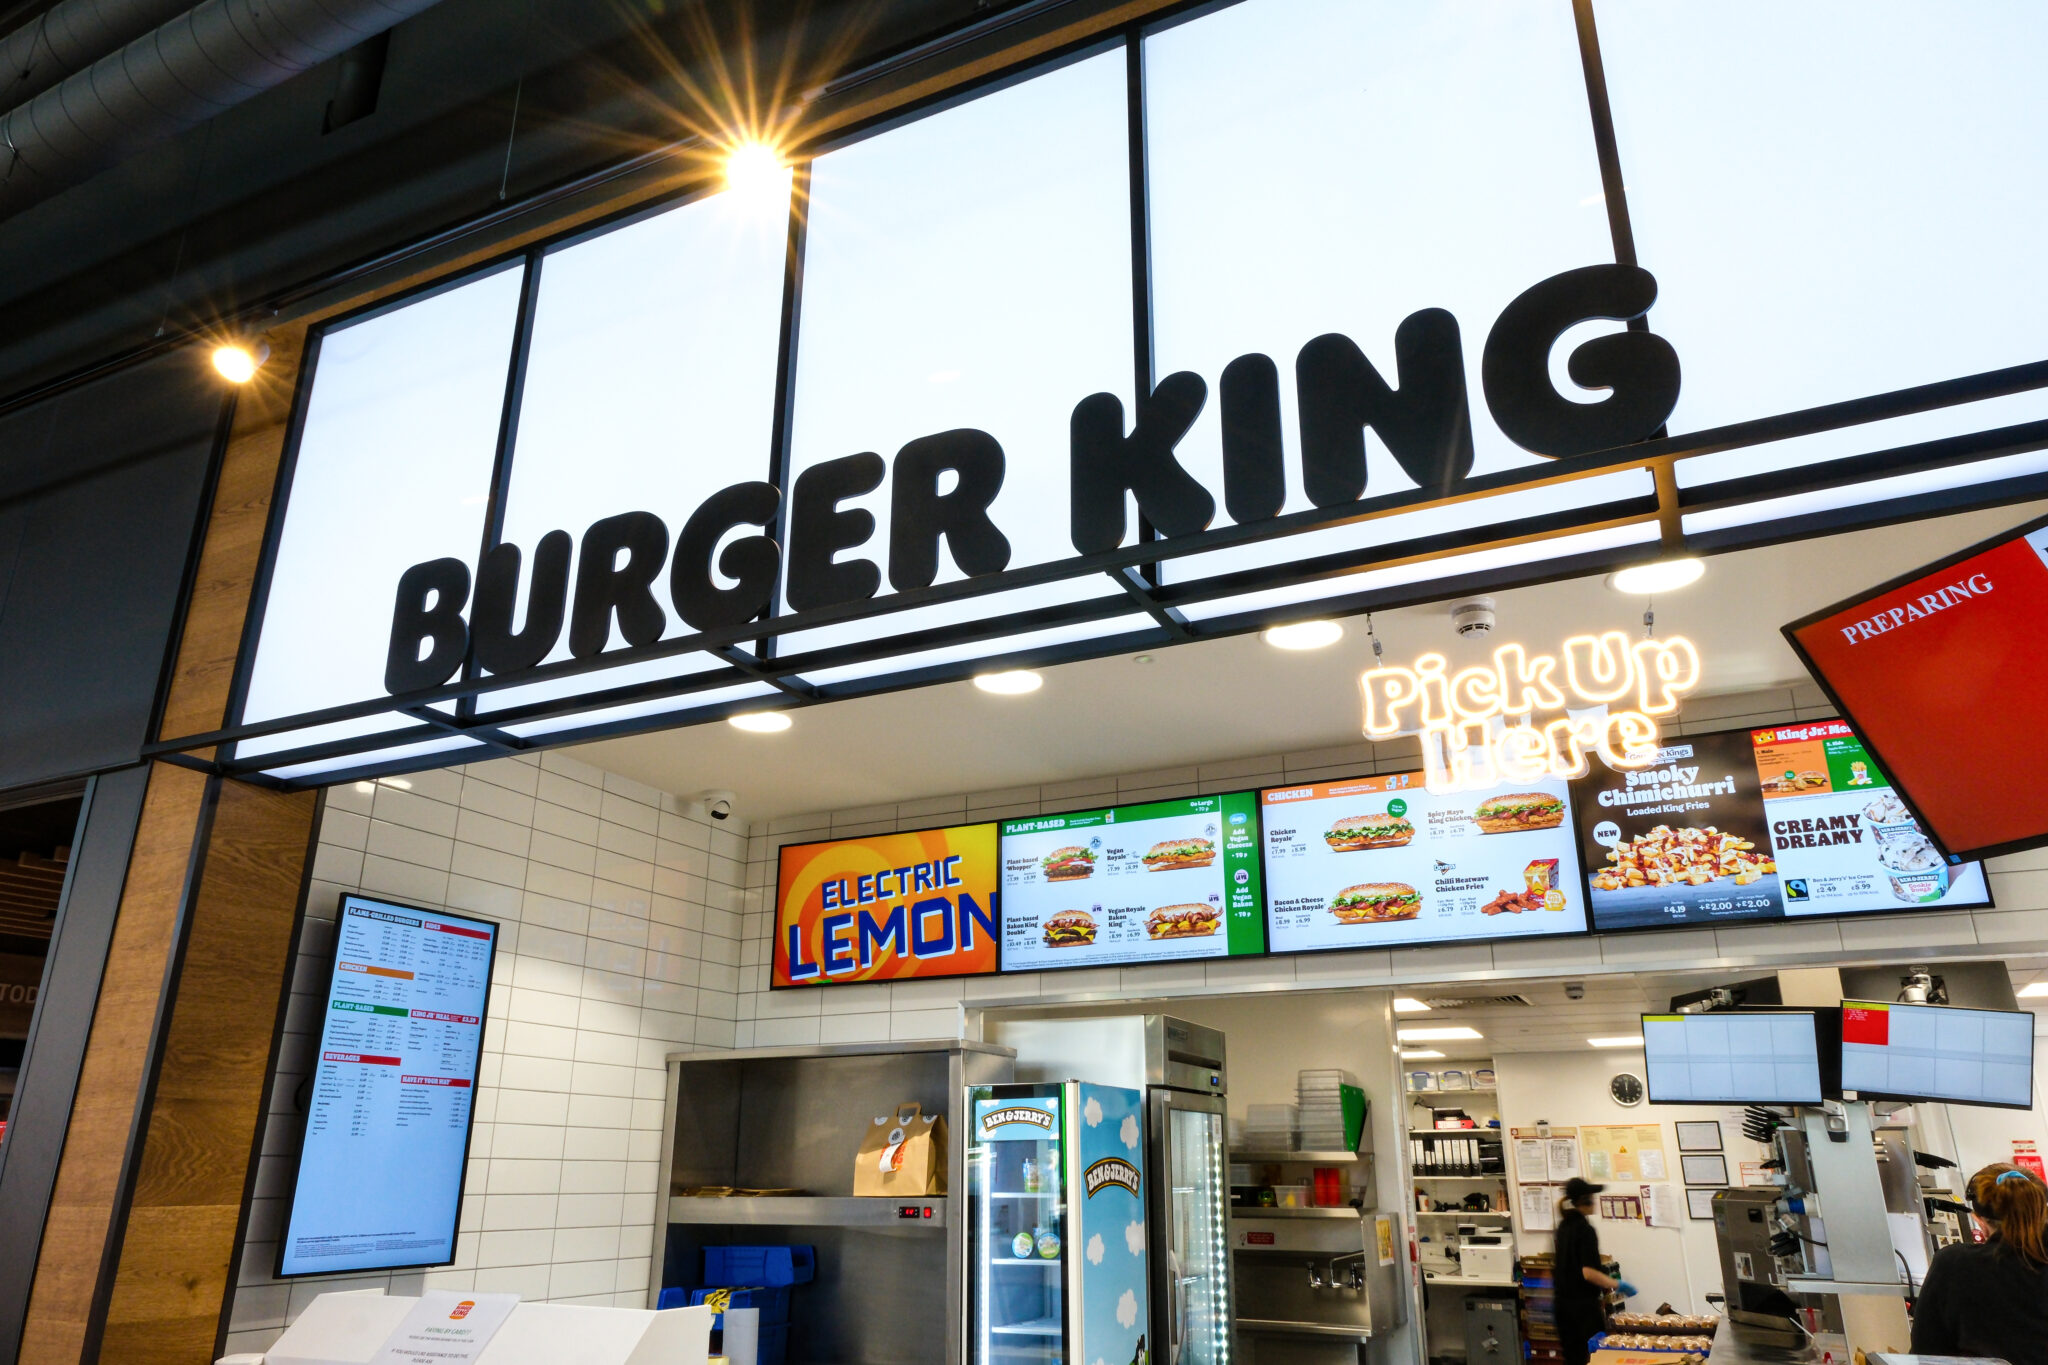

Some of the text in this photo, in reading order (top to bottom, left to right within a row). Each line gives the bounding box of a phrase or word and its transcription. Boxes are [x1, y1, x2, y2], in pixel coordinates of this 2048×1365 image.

[385, 264, 1681, 697] BURGER KING
[1839, 573, 1994, 645] PREPARING
[1361, 631, 1700, 735] Pick Up
[1776, 728, 1808, 740] King
[1420, 711, 1660, 792] Here
[1666, 747, 1689, 759] Kings
[1625, 764, 1699, 786] Smoky
[1267, 788, 1313, 801] CHICKEN
[1598, 776, 1736, 807] Chimichurri
[1428, 809, 1464, 819] Spicy Mayo
[1627, 801, 1710, 816] Loaded King Fries
[1428, 814, 1472, 825] King Chicken
[1773, 814, 1861, 835] CREAMY
[1006, 819, 1065, 833] PLANT-BASED
[1270, 828, 1297, 836] Chicken
[1597, 829, 1617, 837] NEW
[1775, 829, 1864, 850] DREAMY
[1107, 848, 1124, 856] Vegan
[822, 855, 962, 911] ELECTRIC
[1435, 875, 1489, 885] Chilli Heatwave
[1436, 882, 1485, 893] Chicken Fries
[1232, 894, 1252, 902] Vegan
[1301, 896, 1324, 904] Cheese
[350, 908, 394, 922] FLAME-GRILLED
[1108, 906, 1146, 916] Vegan Royale
[1274, 905, 1302, 913] Chicken
[1664, 905, 1686, 913] £4.19
[1006, 915, 1039, 923] Plant-based
[789, 891, 996, 980] LEMON
[333, 1001, 375, 1012] PLANT-BASED
